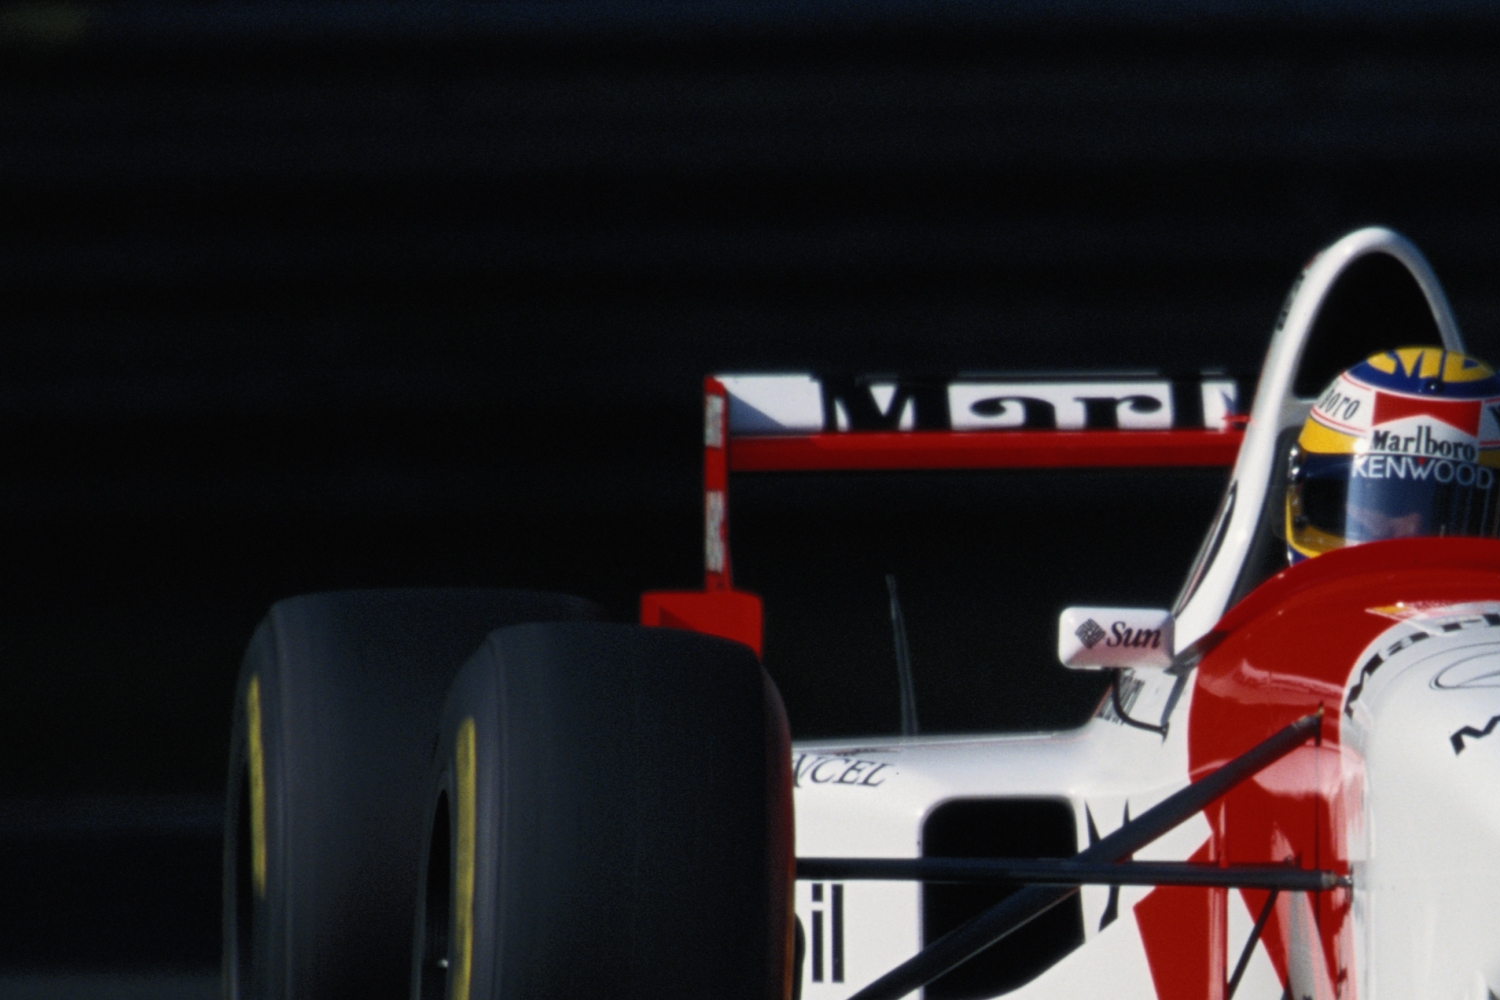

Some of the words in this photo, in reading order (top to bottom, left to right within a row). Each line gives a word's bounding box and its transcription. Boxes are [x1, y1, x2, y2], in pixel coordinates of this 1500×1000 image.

[1372, 426, 1477, 461] Marlboro
[1352, 456, 1495, 490] KENWOOD
[1106, 621, 1161, 649] Sun
